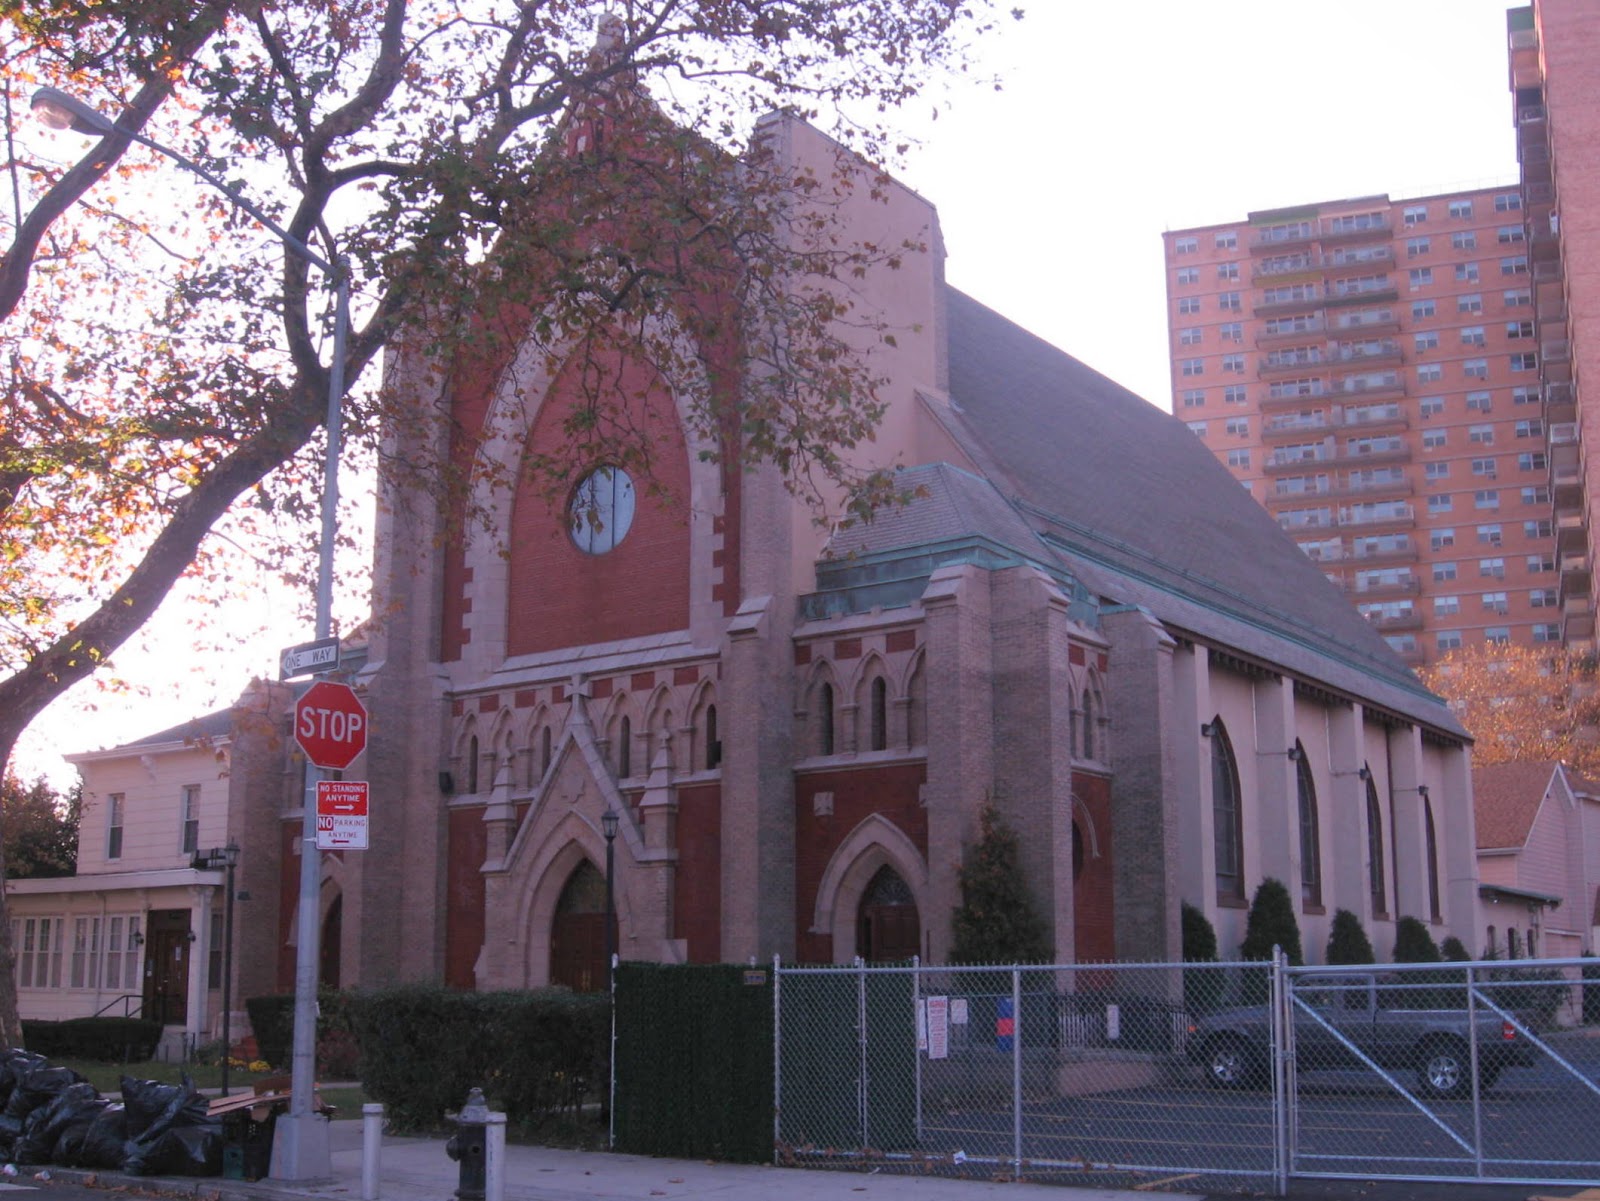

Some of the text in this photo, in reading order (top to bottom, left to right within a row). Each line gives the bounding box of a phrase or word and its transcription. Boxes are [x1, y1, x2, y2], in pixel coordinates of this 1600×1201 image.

[285, 648, 332, 669] ONE WAY
[300, 706, 362, 743] STOP
[320, 785, 366, 793] NO STANDING
[325, 794, 360, 802] ANYTIME
[318, 817, 333, 829] NO
[328, 831, 357, 839] ANYTIME
